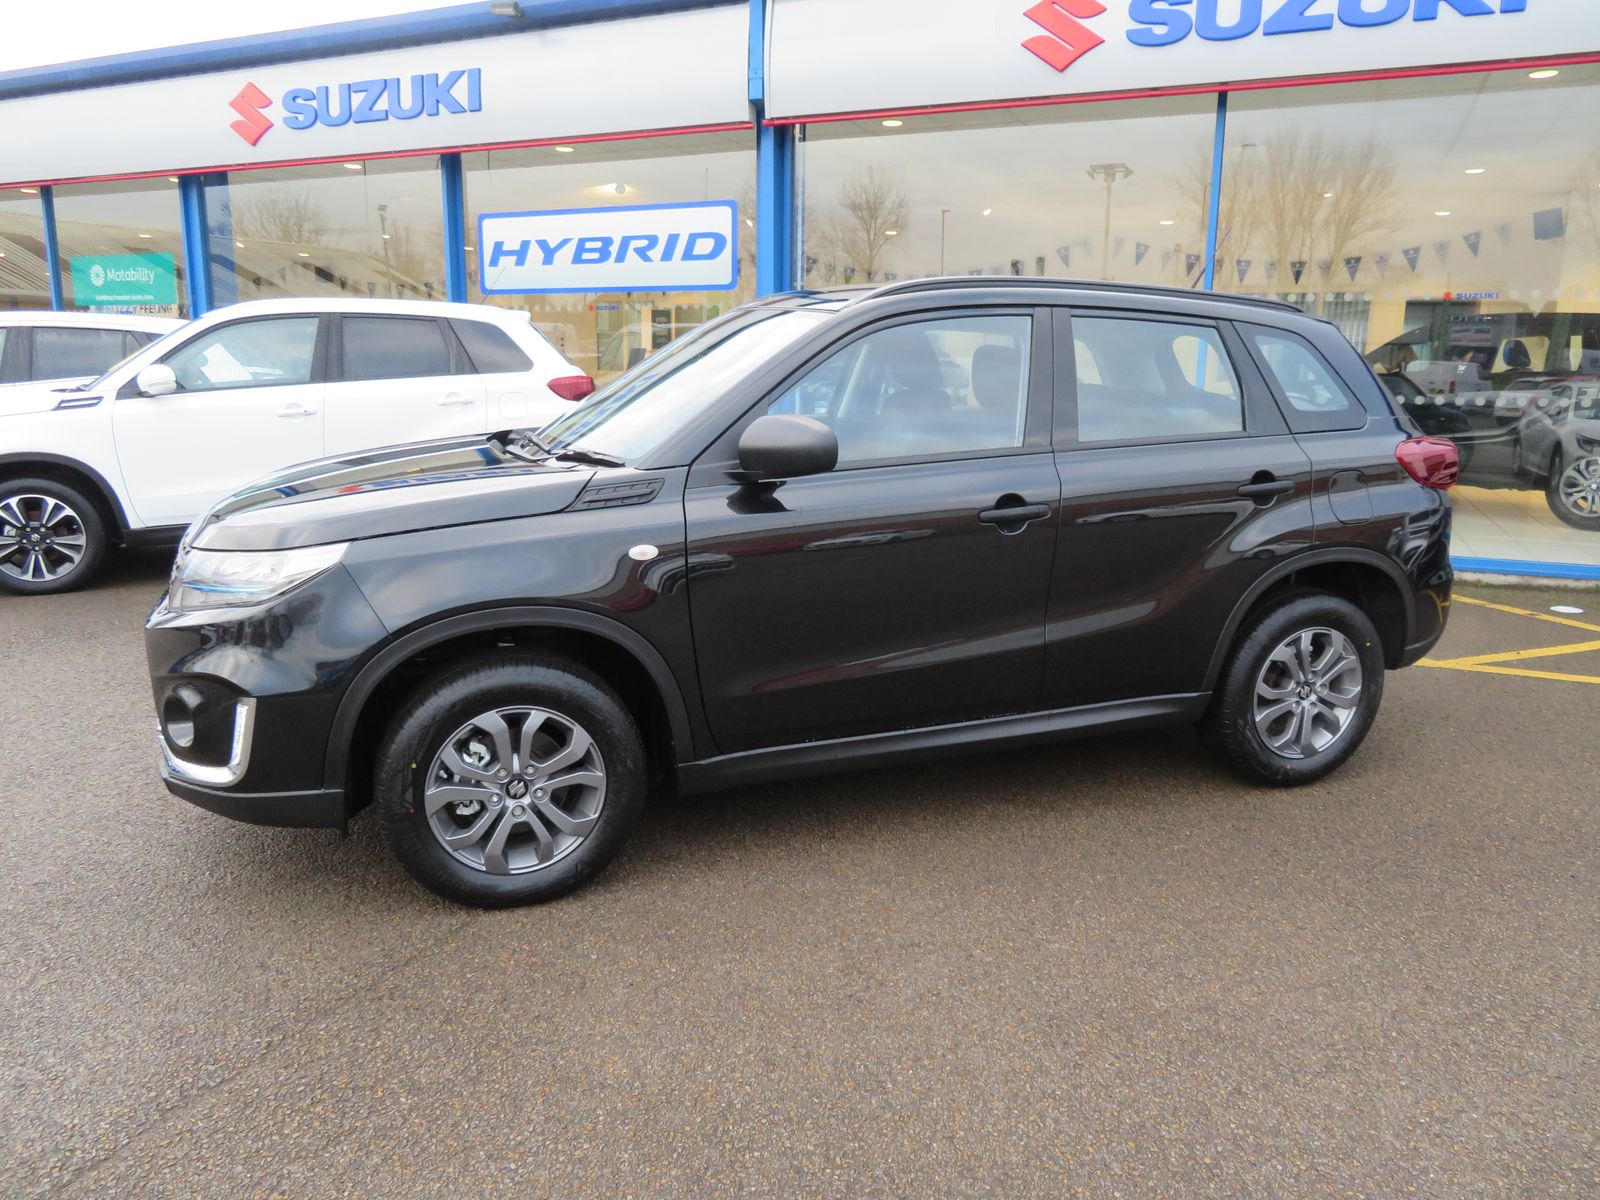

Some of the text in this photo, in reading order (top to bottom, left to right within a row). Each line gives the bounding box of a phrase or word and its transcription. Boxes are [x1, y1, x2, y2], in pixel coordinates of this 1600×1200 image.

[1126, 0, 1527, 47] SUZ
[281, 67, 482, 130] SUZUKI
[488, 232, 727, 267] HYBRID
[106, 267, 155, 285] Motability
